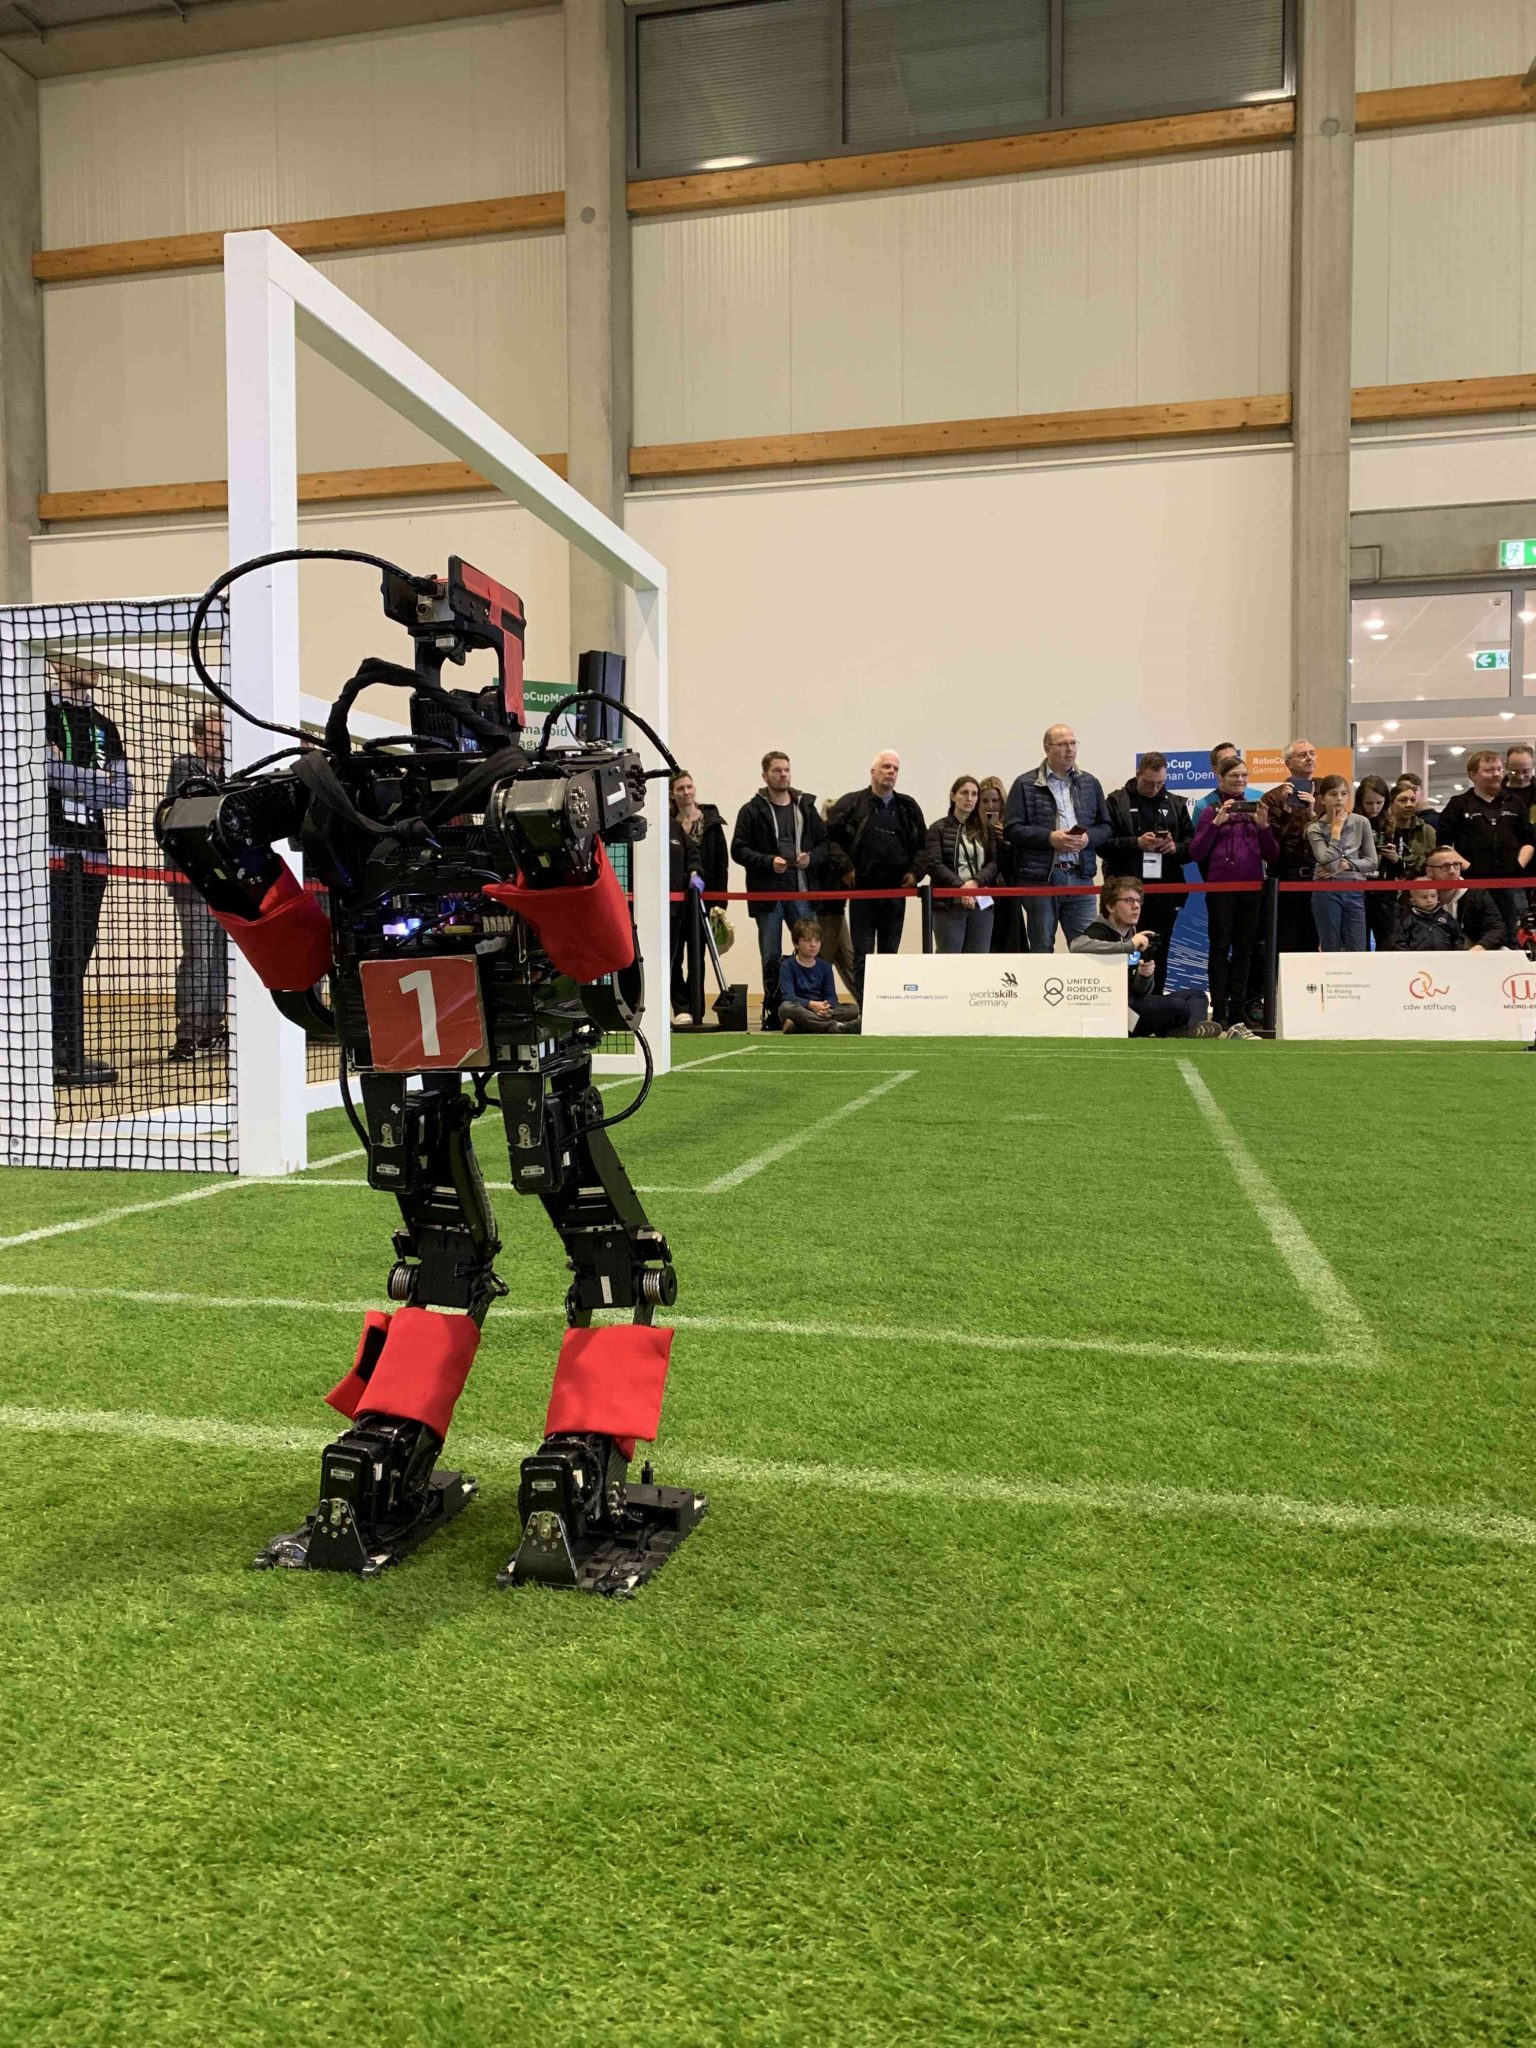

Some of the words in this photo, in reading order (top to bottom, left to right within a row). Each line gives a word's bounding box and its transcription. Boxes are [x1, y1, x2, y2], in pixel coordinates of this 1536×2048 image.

[1252, 756, 1285, 765] RoboCu
[1186, 770, 1215, 782] Open
[969, 989, 1018, 999] worldskills
[968, 999, 1009, 1009] Germany
[1403, 1003, 1420, 1011] cdw
[1423, 1003, 1457, 1012] stiftung
[398, 969, 441, 1057] 1
